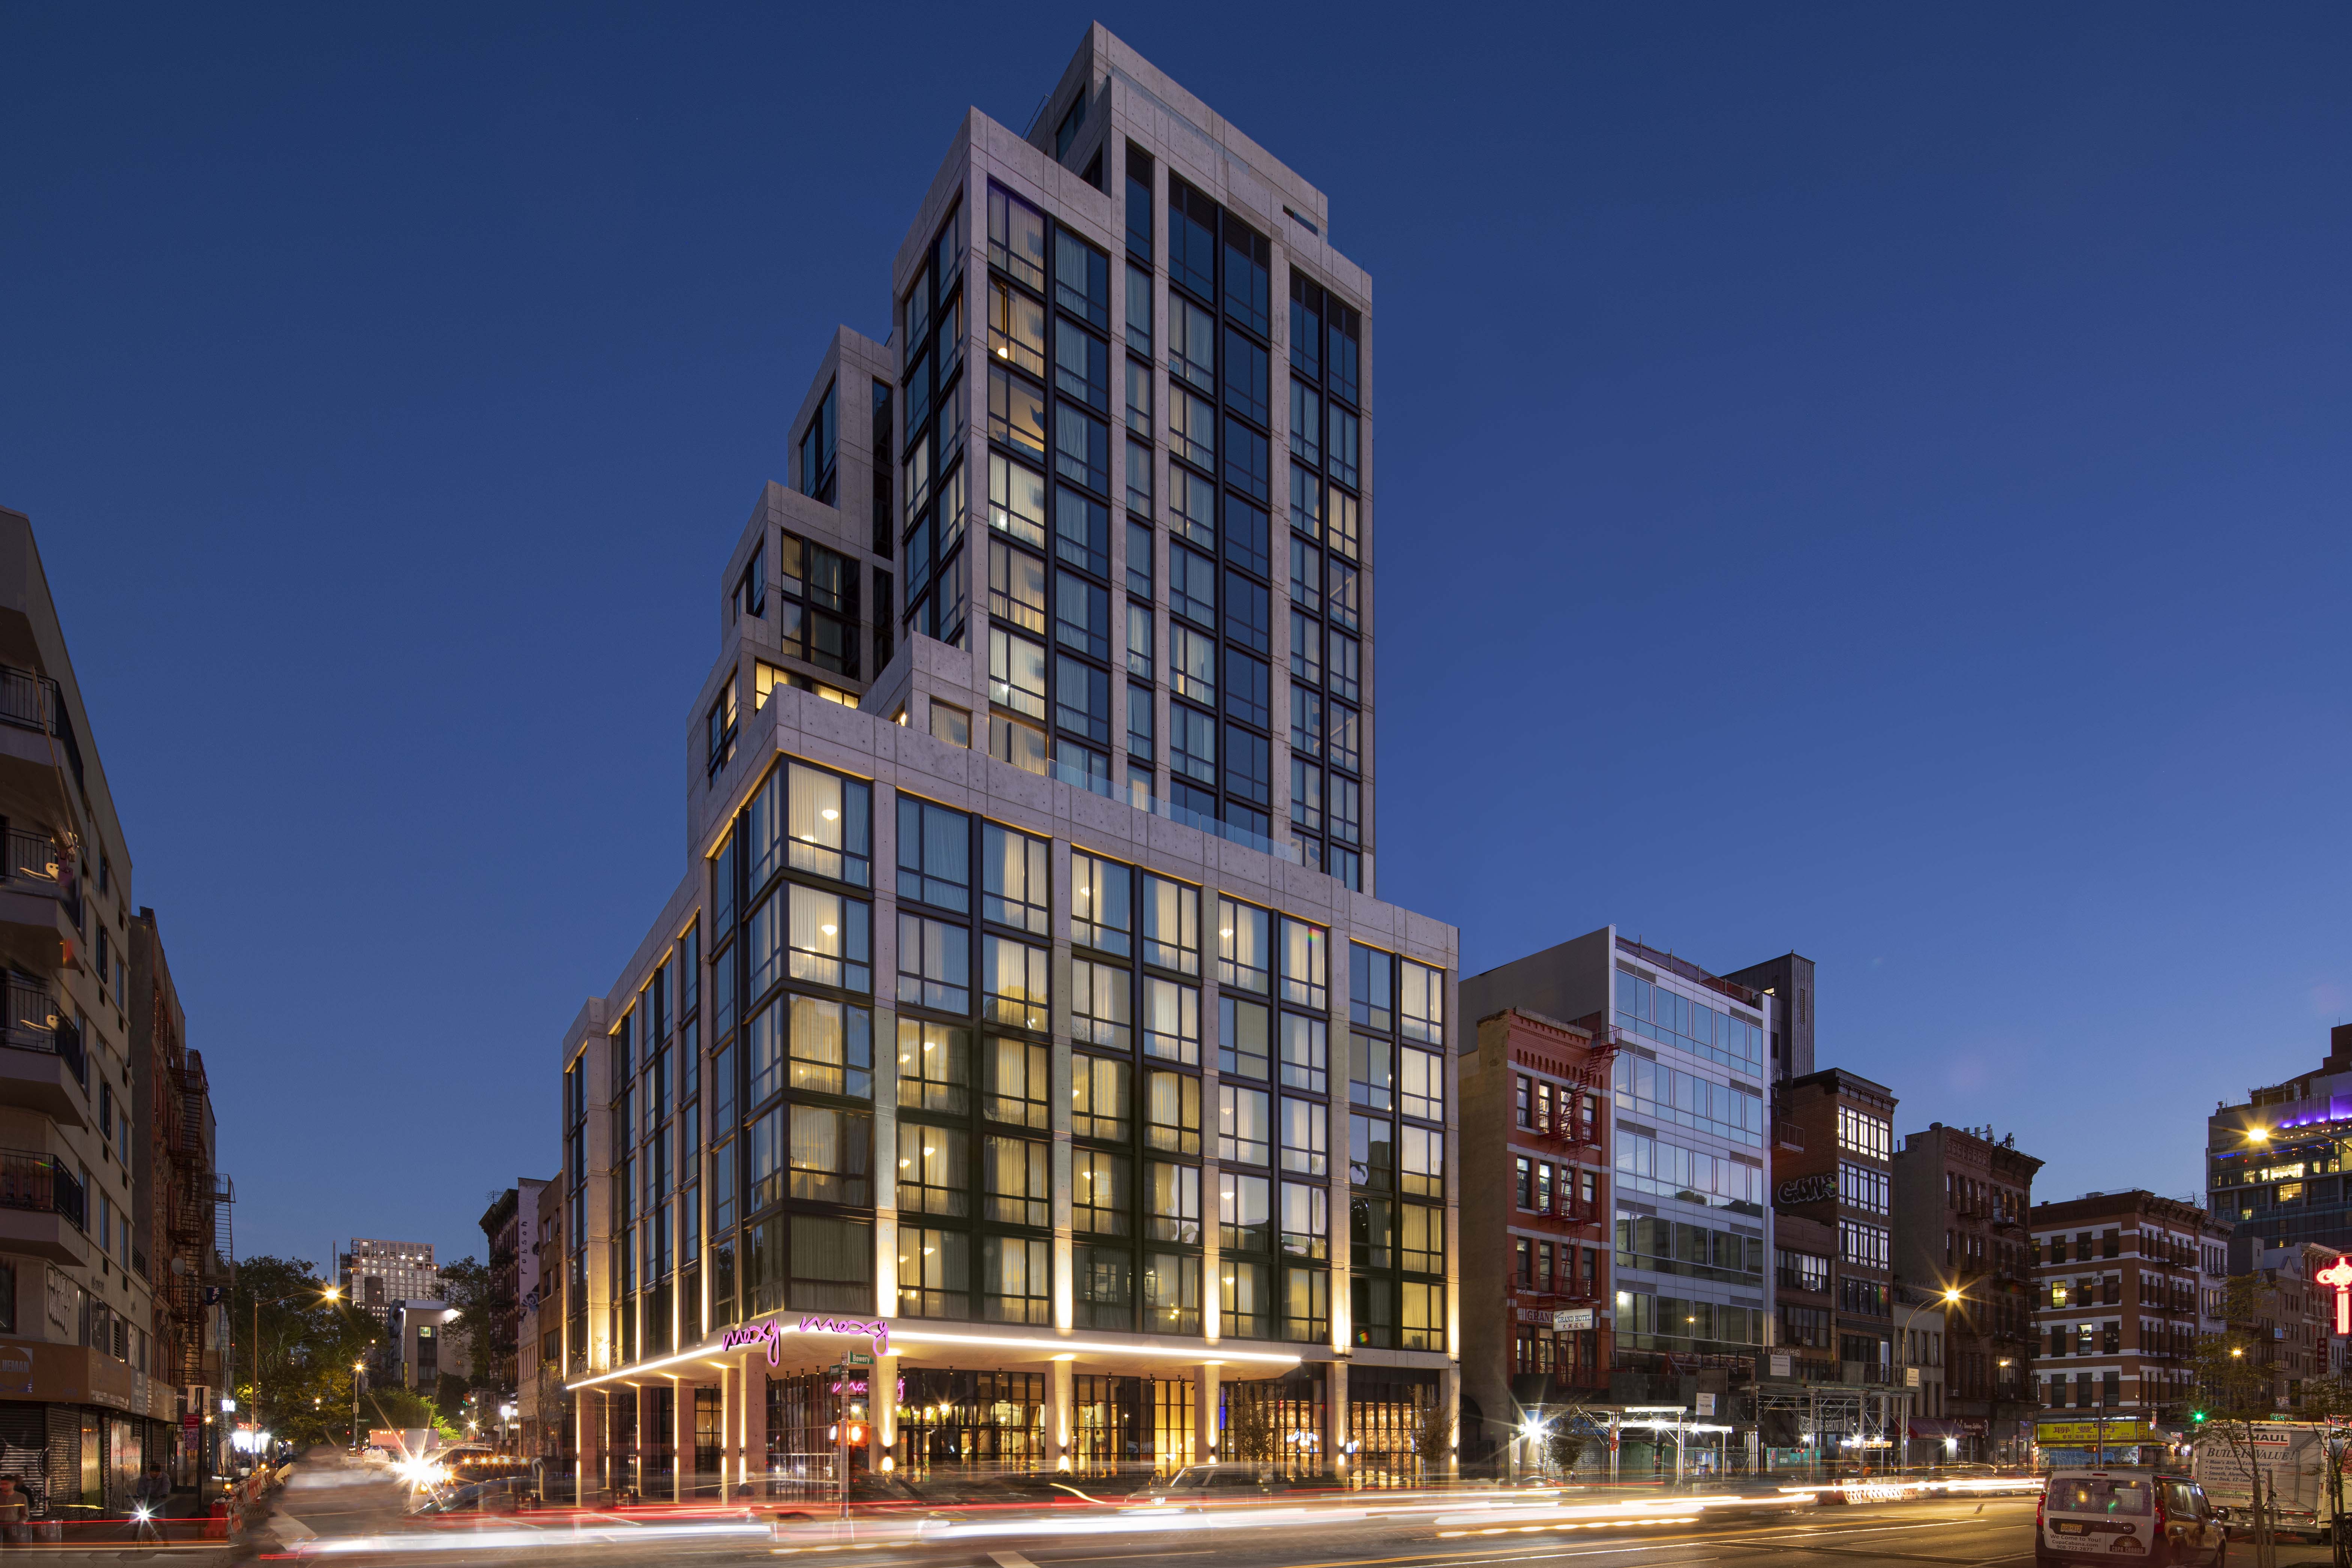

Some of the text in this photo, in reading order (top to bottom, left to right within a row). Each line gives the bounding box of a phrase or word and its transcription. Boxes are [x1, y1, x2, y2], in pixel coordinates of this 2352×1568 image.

[1527, 1310, 1553, 1322] GRAN
[722, 1318, 780, 1367] moxy
[799, 1316, 889, 1357] moxy
[853, 1355, 870, 1364] Bowery
[2052, 1540, 2099, 1548] CupaCabana.com
